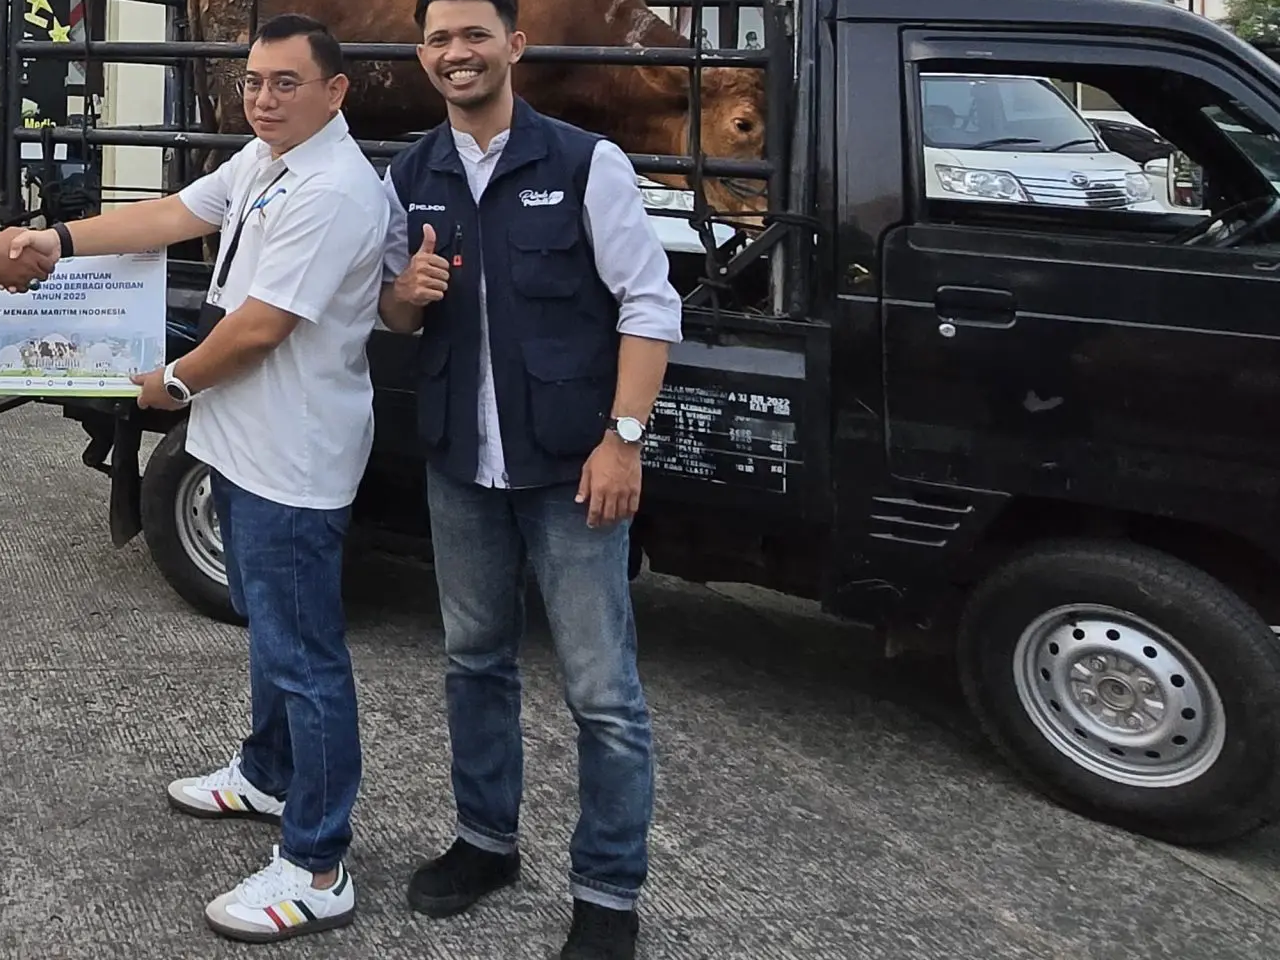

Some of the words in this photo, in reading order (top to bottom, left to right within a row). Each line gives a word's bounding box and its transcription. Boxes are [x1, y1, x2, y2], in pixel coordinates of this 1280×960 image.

[69, 272, 112, 280] BANTUAN
[63, 282, 104, 290] BERBAGI
[104, 281, 144, 290] QURBAN
[31, 293, 62, 301] TAHUN
[3, 308, 39, 316] MENARA
[40, 308, 77, 316] MARITIM
[79, 308, 126, 316] INDONESIA
